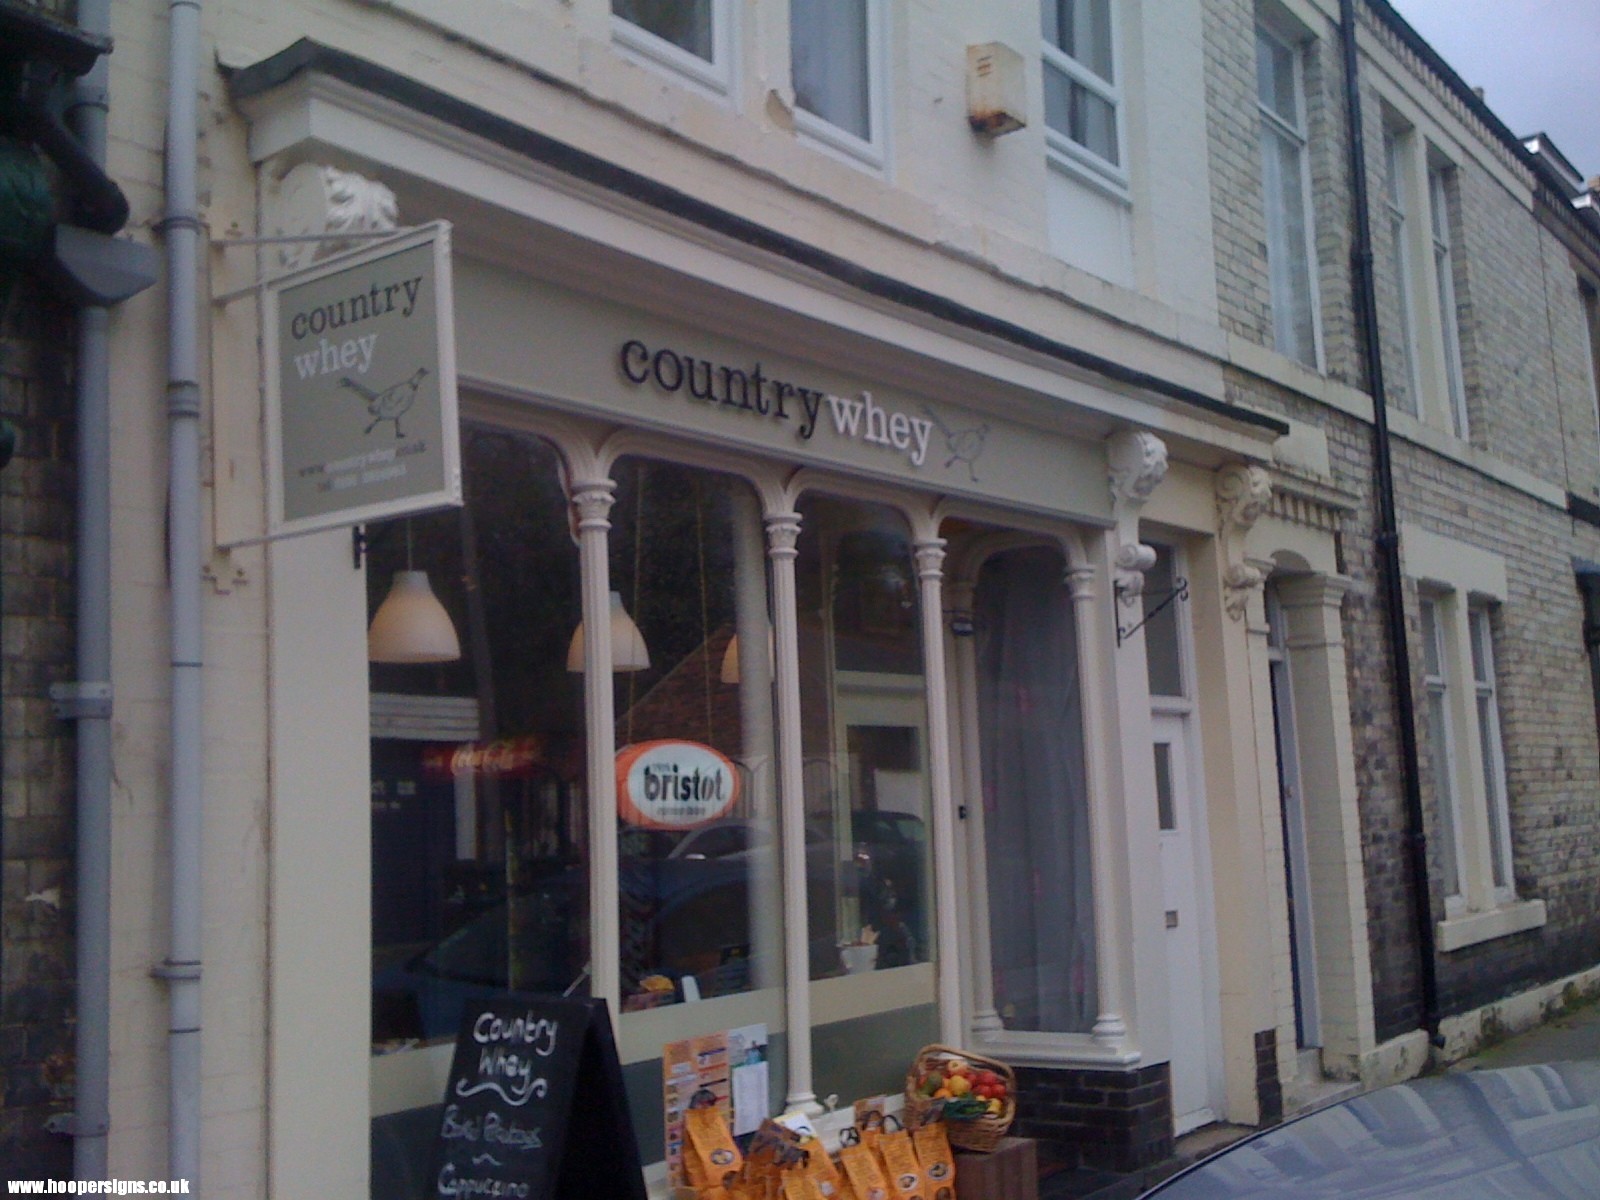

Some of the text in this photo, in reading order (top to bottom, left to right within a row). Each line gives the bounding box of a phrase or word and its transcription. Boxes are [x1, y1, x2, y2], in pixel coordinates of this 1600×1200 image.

[291, 275, 423, 341] country
[293, 333, 378, 380] whey
[620, 339, 934, 466] country whey
[643, 763, 725, 802] bristot
[473, 1010, 559, 1056] Country
